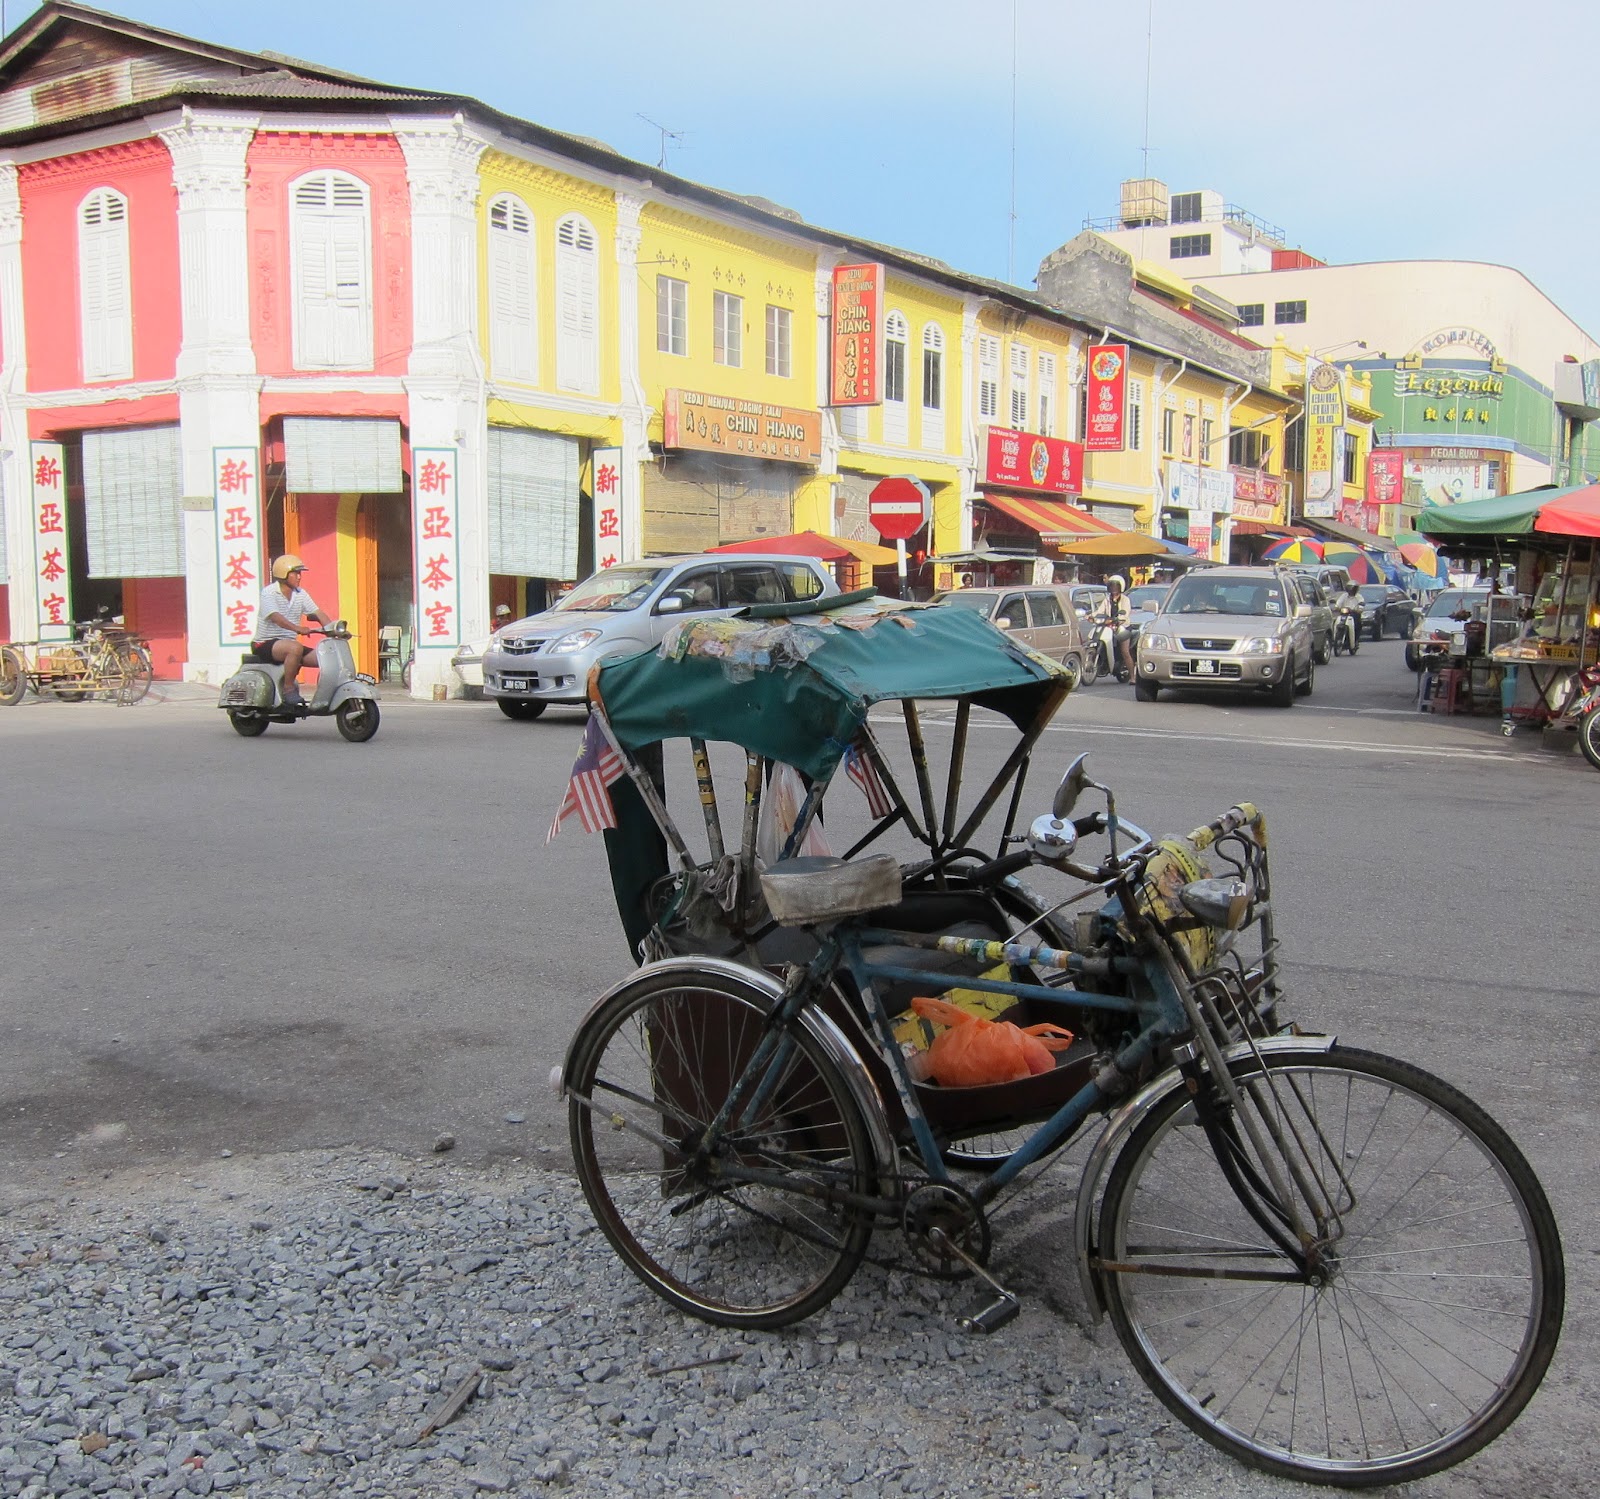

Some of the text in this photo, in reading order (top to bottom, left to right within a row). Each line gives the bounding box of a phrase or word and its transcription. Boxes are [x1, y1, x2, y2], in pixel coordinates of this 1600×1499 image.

[840, 306, 868, 320] CHIN
[836, 320, 871, 334] HIANG
[1408, 372, 1503, 396] Legenda
[684, 392, 782, 418] KEDAI MENJUAL DAGING SALAI
[726, 415, 804, 440] CHIN HIANG
[1431, 448, 1479, 459] KEDAI BUKU
[1423, 465, 1470, 475] POPULAR
[35, 455, 66, 625] 新亞茶室
[219, 458, 256, 637] 新亞茶室
[419, 459, 453, 637] 新亞茶室
